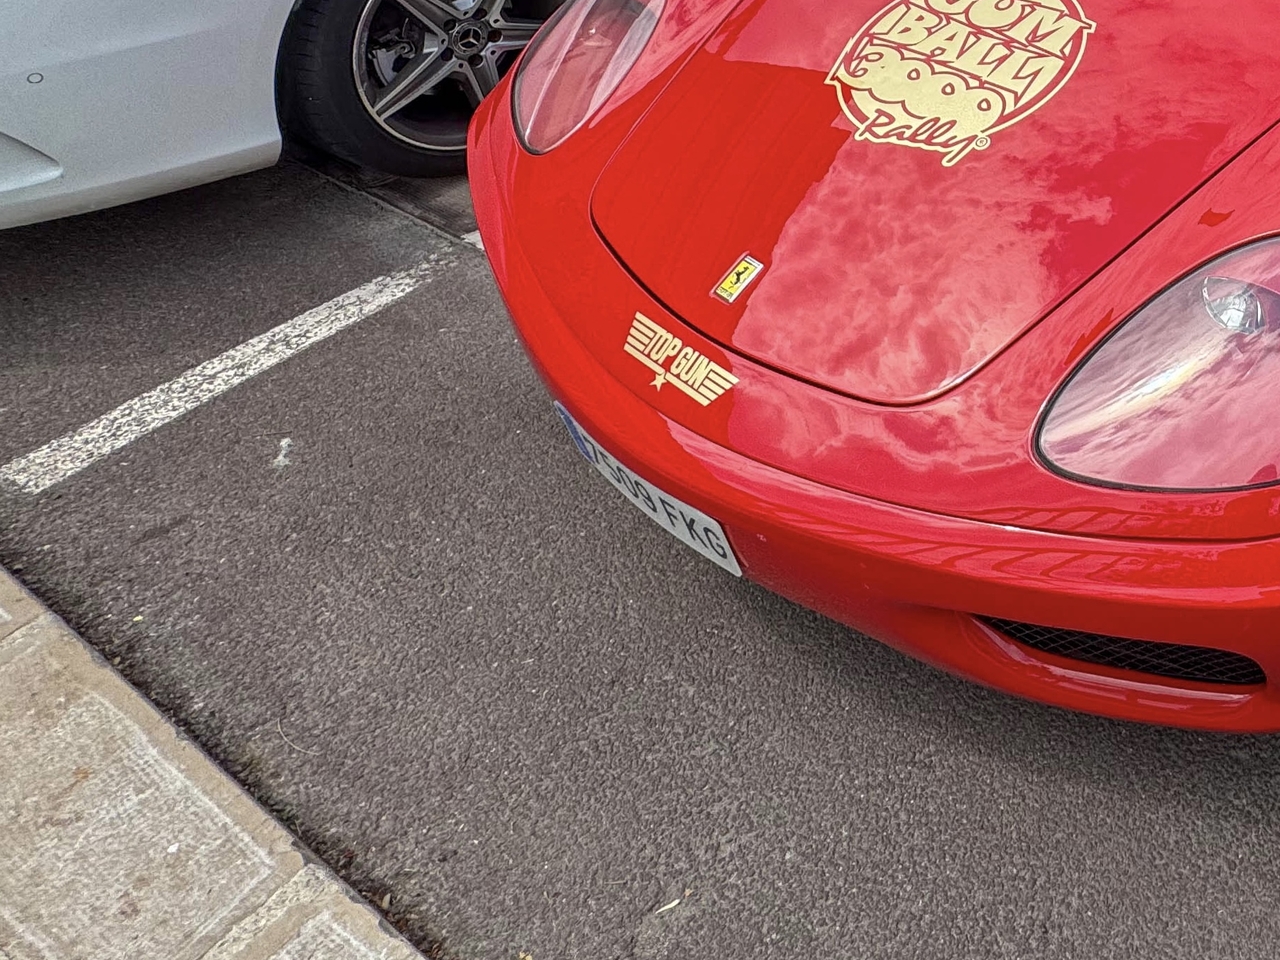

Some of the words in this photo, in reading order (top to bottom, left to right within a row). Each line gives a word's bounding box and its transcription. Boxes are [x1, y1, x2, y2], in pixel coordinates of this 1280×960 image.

[836, 38, 1006, 134] 3000
[868, 2, 1066, 108] BALL
[859, 108, 979, 164] Rally
[643, 329, 683, 366] TOP
[669, 346, 712, 391] GUN
[658, 495, 729, 560] FKG
